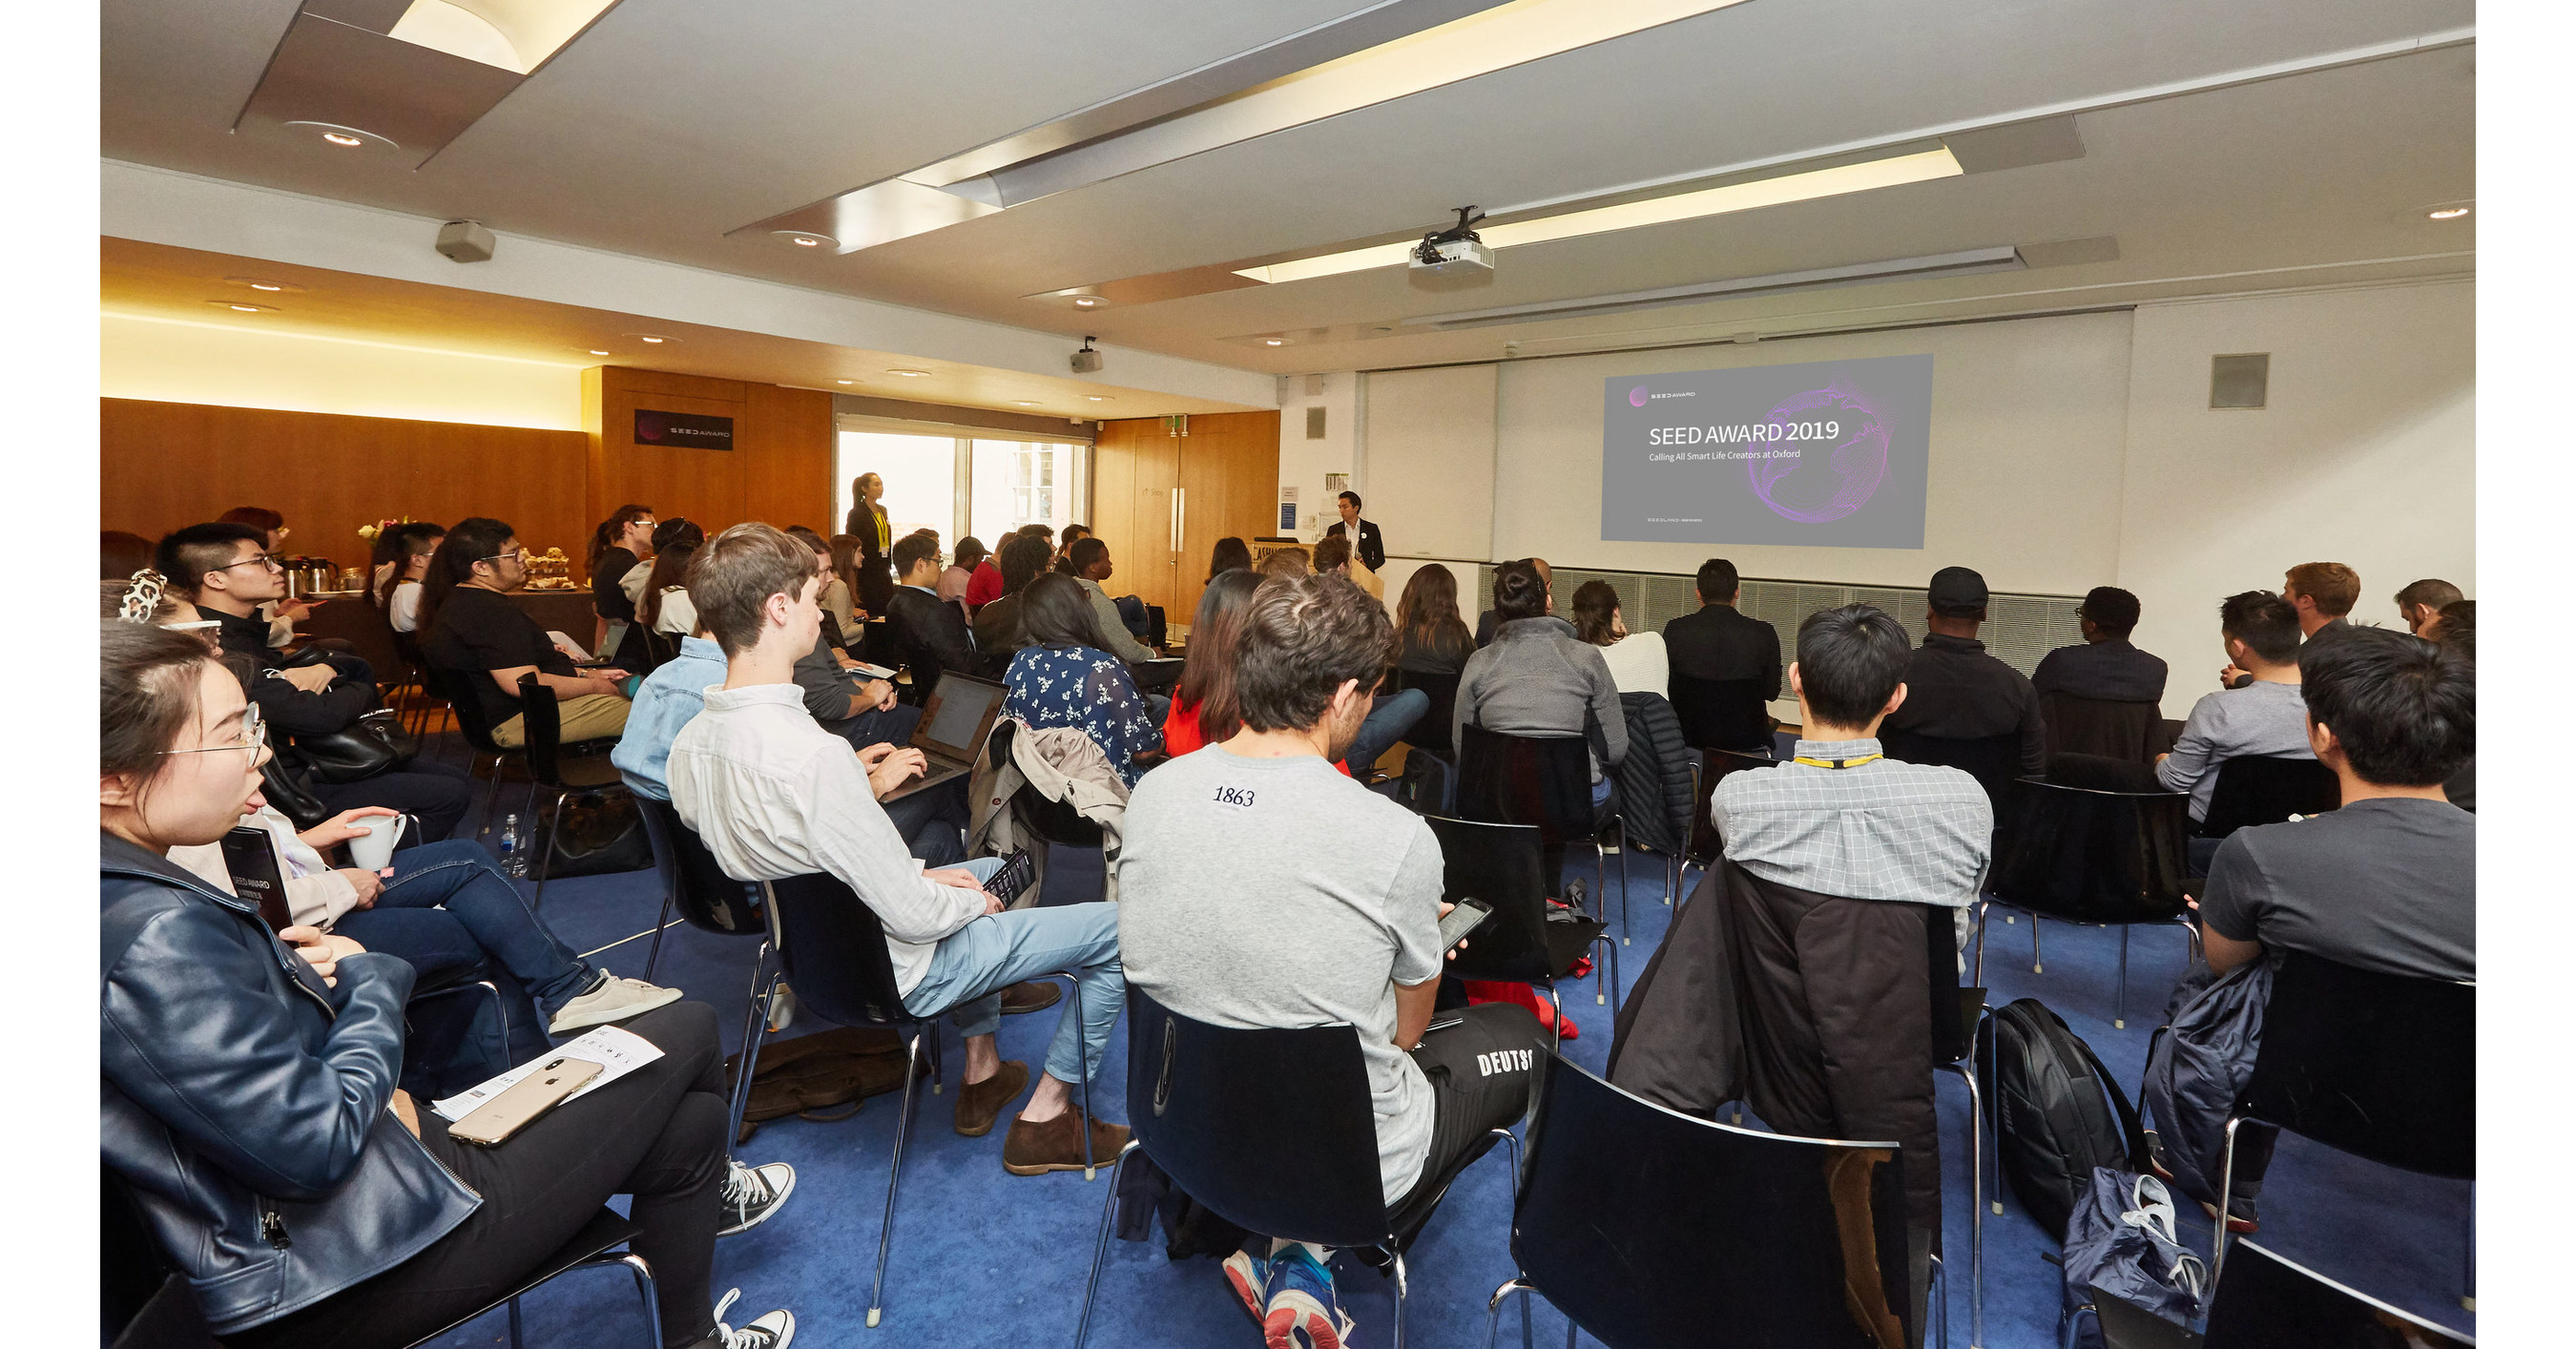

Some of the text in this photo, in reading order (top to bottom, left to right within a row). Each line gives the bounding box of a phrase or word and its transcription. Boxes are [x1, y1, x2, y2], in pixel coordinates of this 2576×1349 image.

[1650, 421, 1839, 446] SEED AWARD 2019
[1649, 448, 1800, 463] Calling All Smart Life Creators at Oxford
[1213, 785, 1255, 807] 1863
